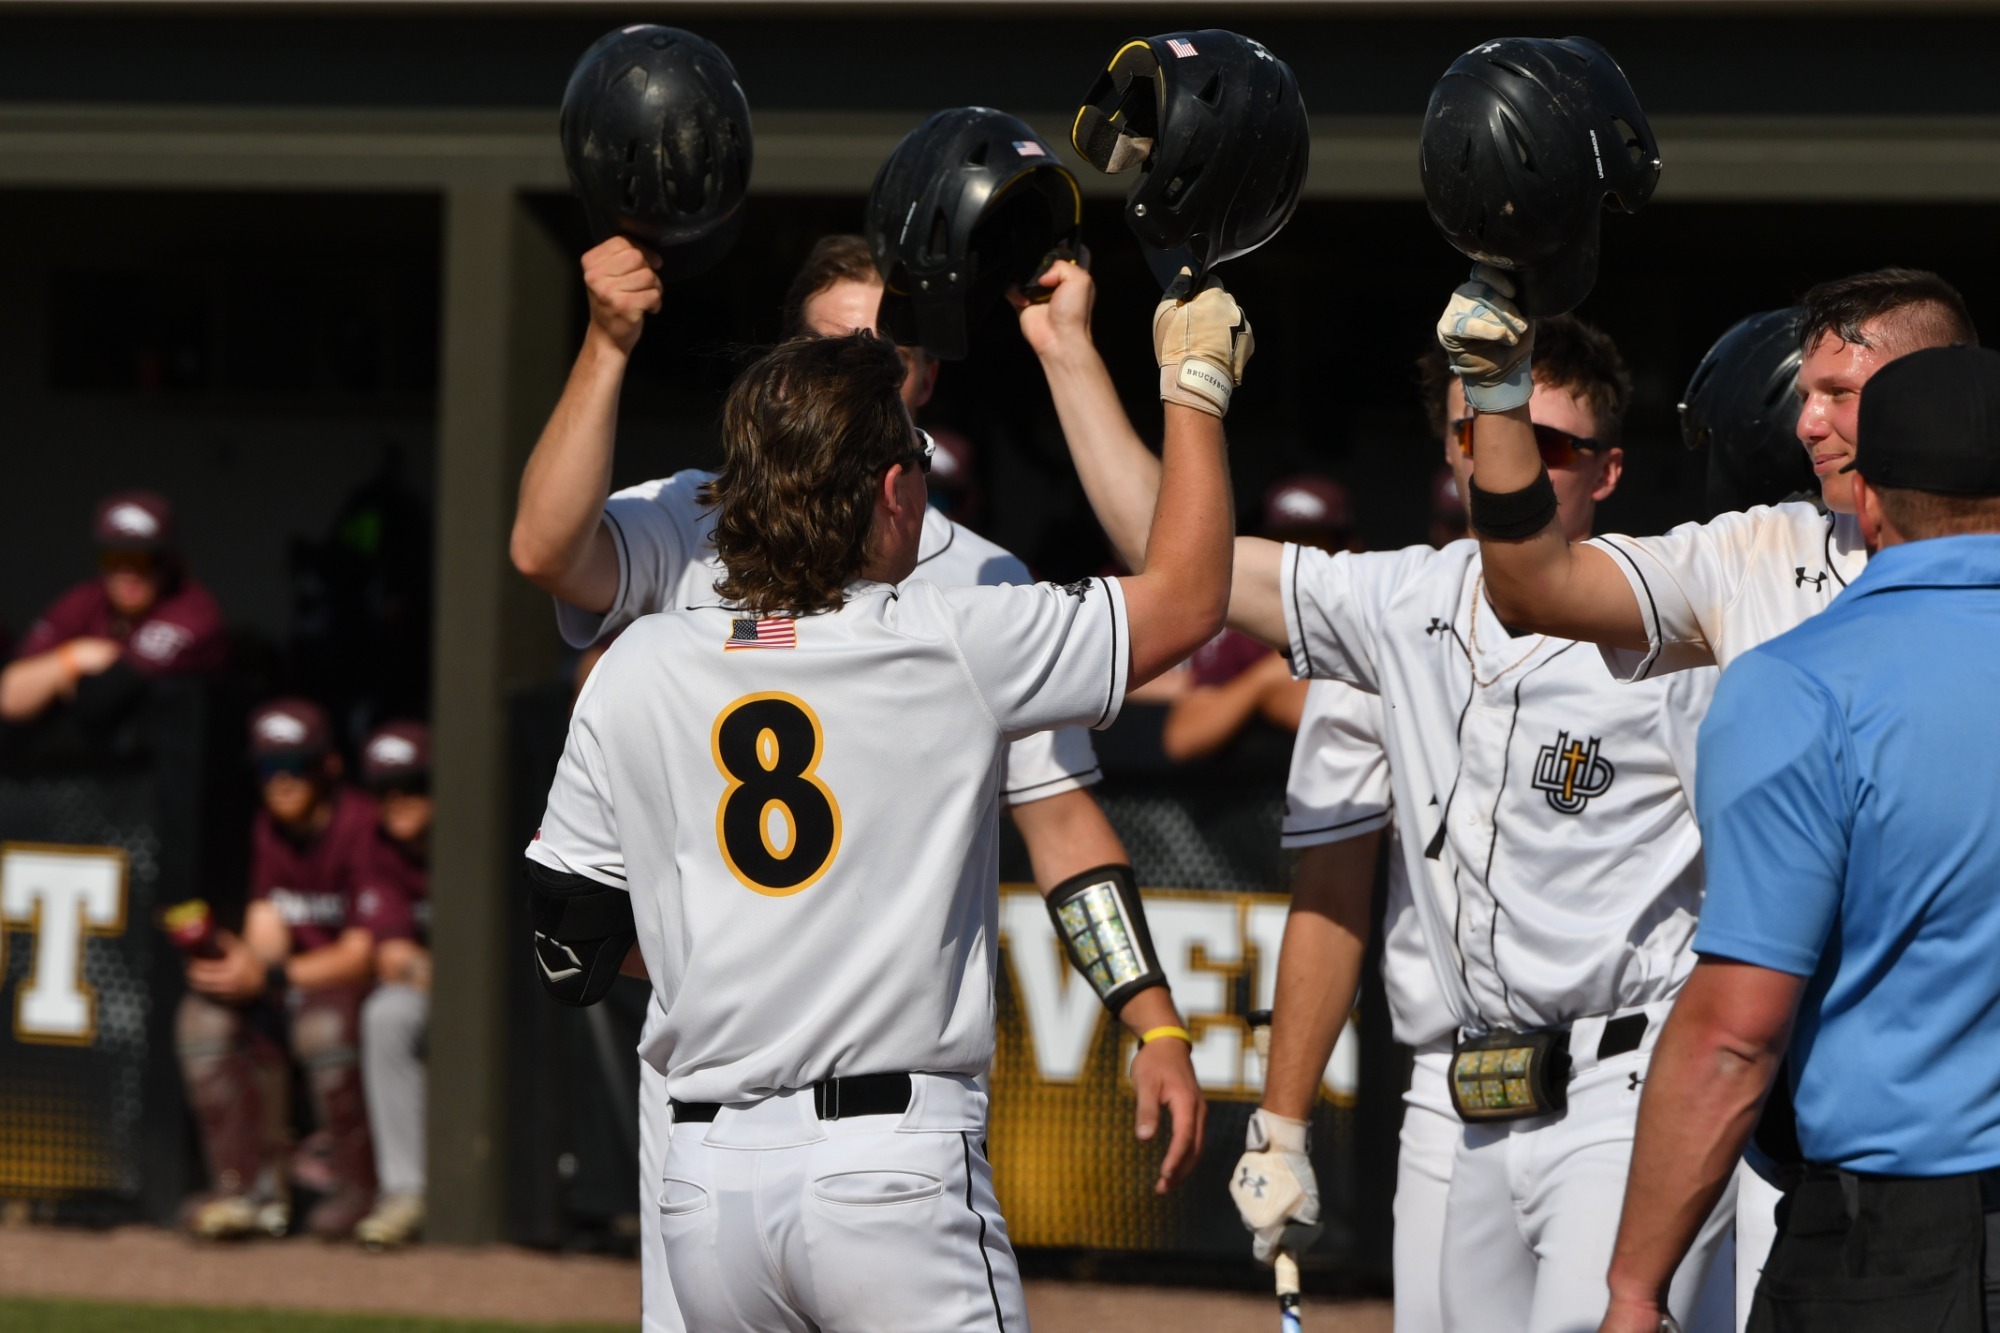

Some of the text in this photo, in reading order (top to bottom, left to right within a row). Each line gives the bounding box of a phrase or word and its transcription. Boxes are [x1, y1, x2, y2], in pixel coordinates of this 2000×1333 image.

[1186, 368, 1214, 384] BRUCE
[711, 690, 843, 897] 8
[0, 840, 130, 1047] T
